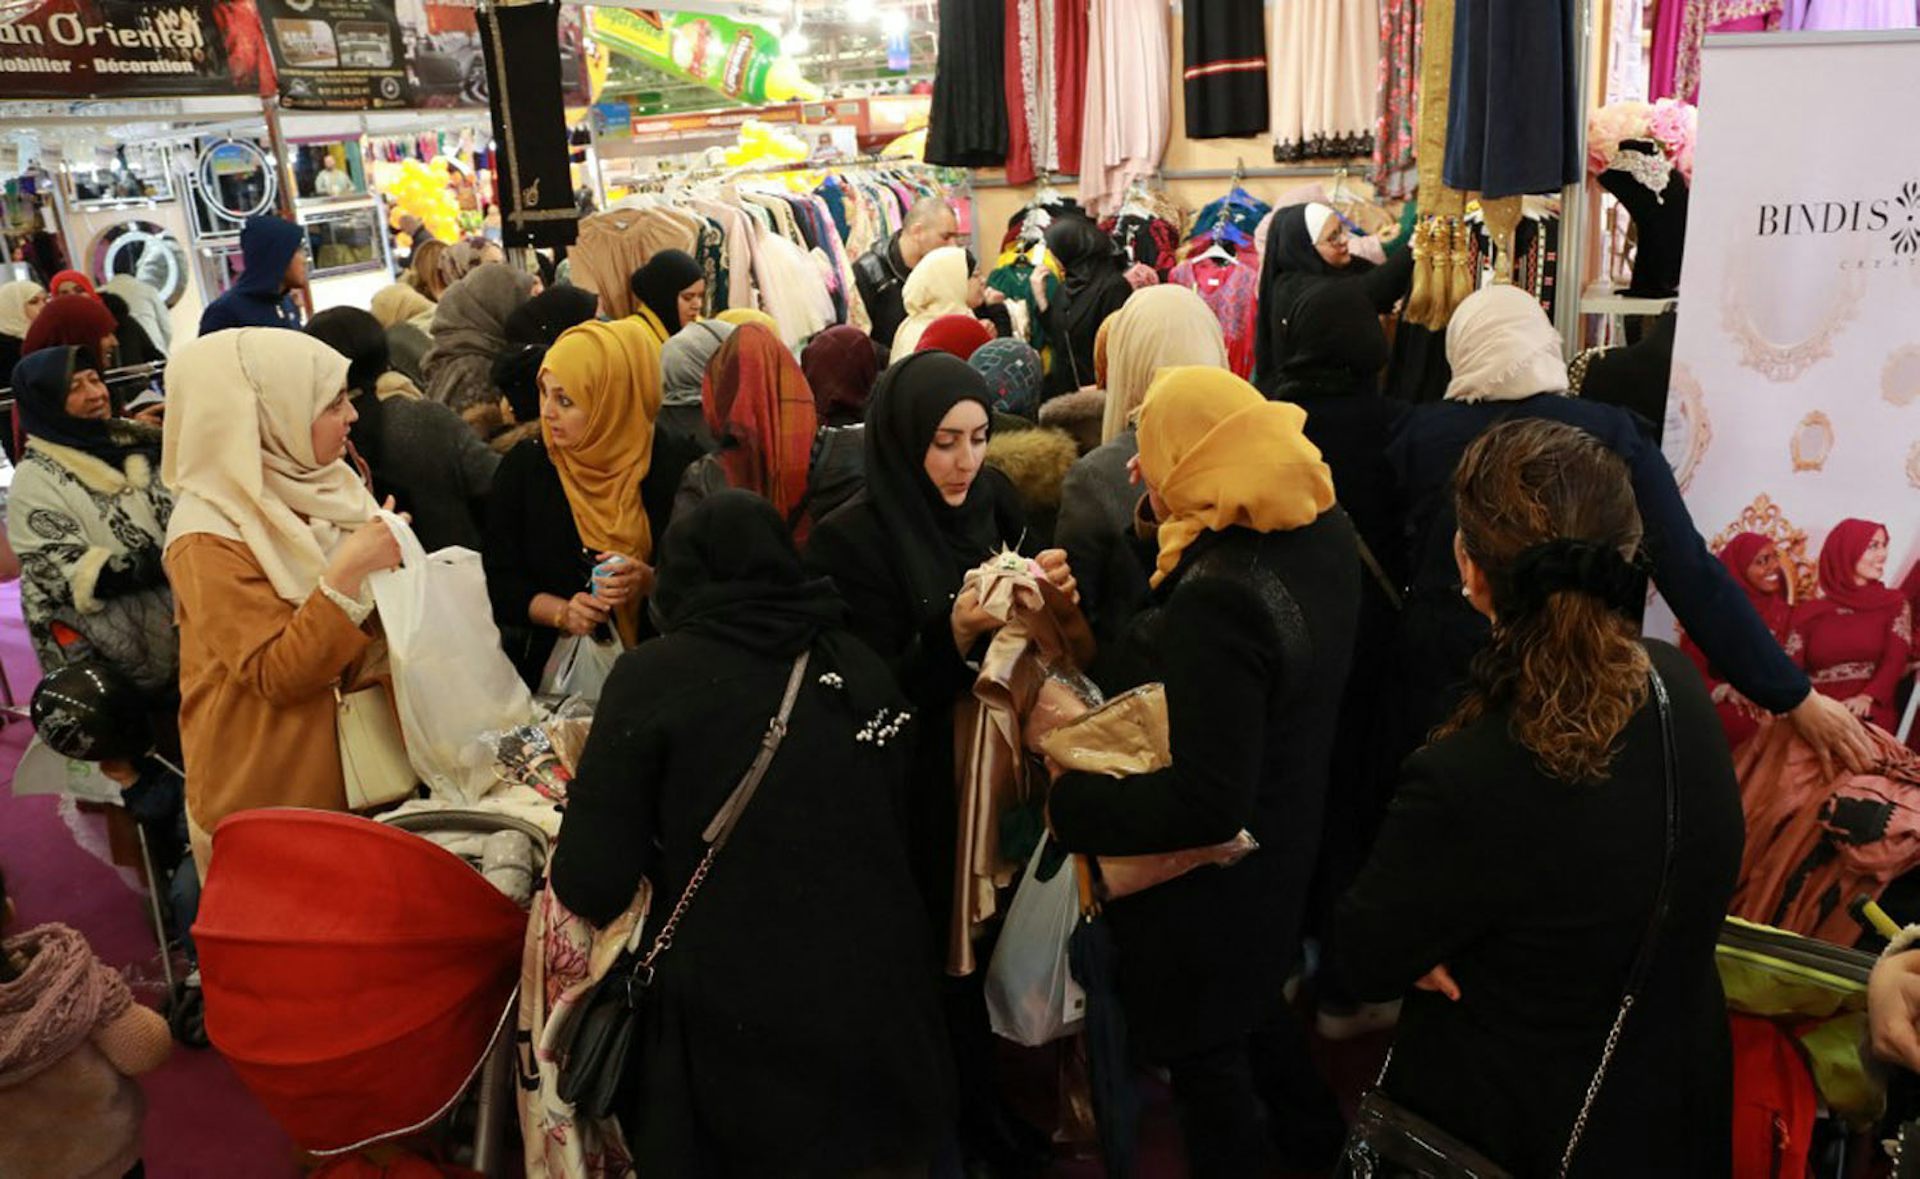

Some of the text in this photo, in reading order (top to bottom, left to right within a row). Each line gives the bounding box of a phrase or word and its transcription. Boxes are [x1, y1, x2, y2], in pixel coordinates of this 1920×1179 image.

[48, 12, 205, 49] Oriental
[0, 57, 72, 73] obilier
[93, 57, 195, 73] Décoration
[1755, 199, 1889, 236] BINDIS
